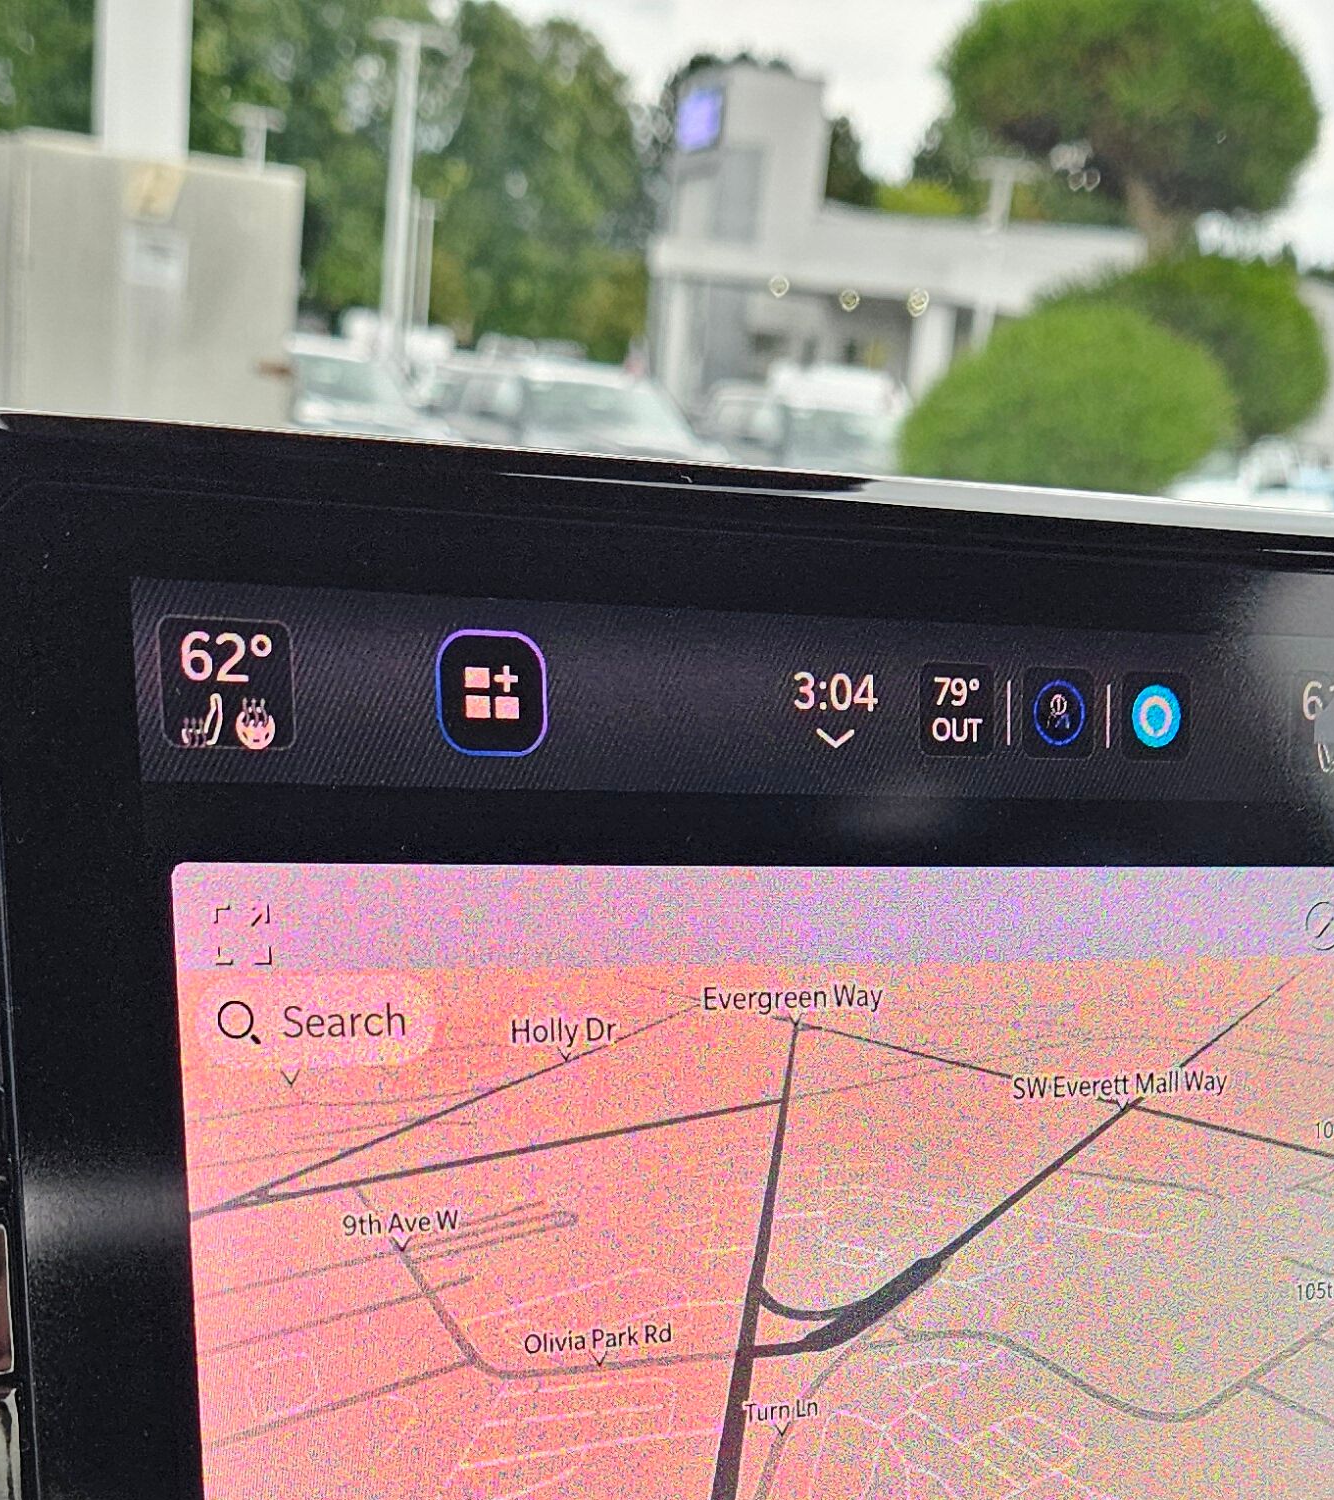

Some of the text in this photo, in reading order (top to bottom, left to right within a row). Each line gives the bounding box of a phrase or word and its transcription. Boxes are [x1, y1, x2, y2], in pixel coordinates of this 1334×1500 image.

[793, 672, 879, 712] 3:04
[931, 717, 983, 744] OUT
[703, 983, 883, 1014] Evergreen Way
[283, 1004, 406, 1037] Search
[511, 1018, 617, 1047] Holly Dr
[1013, 1070, 1228, 1100] SW Everett Mall Way
[343, 1210, 459, 1236] 9th Ave W
[524, 1323, 673, 1355] Olivia Park Rd
[745, 1400, 819, 1422] Turn Ln
